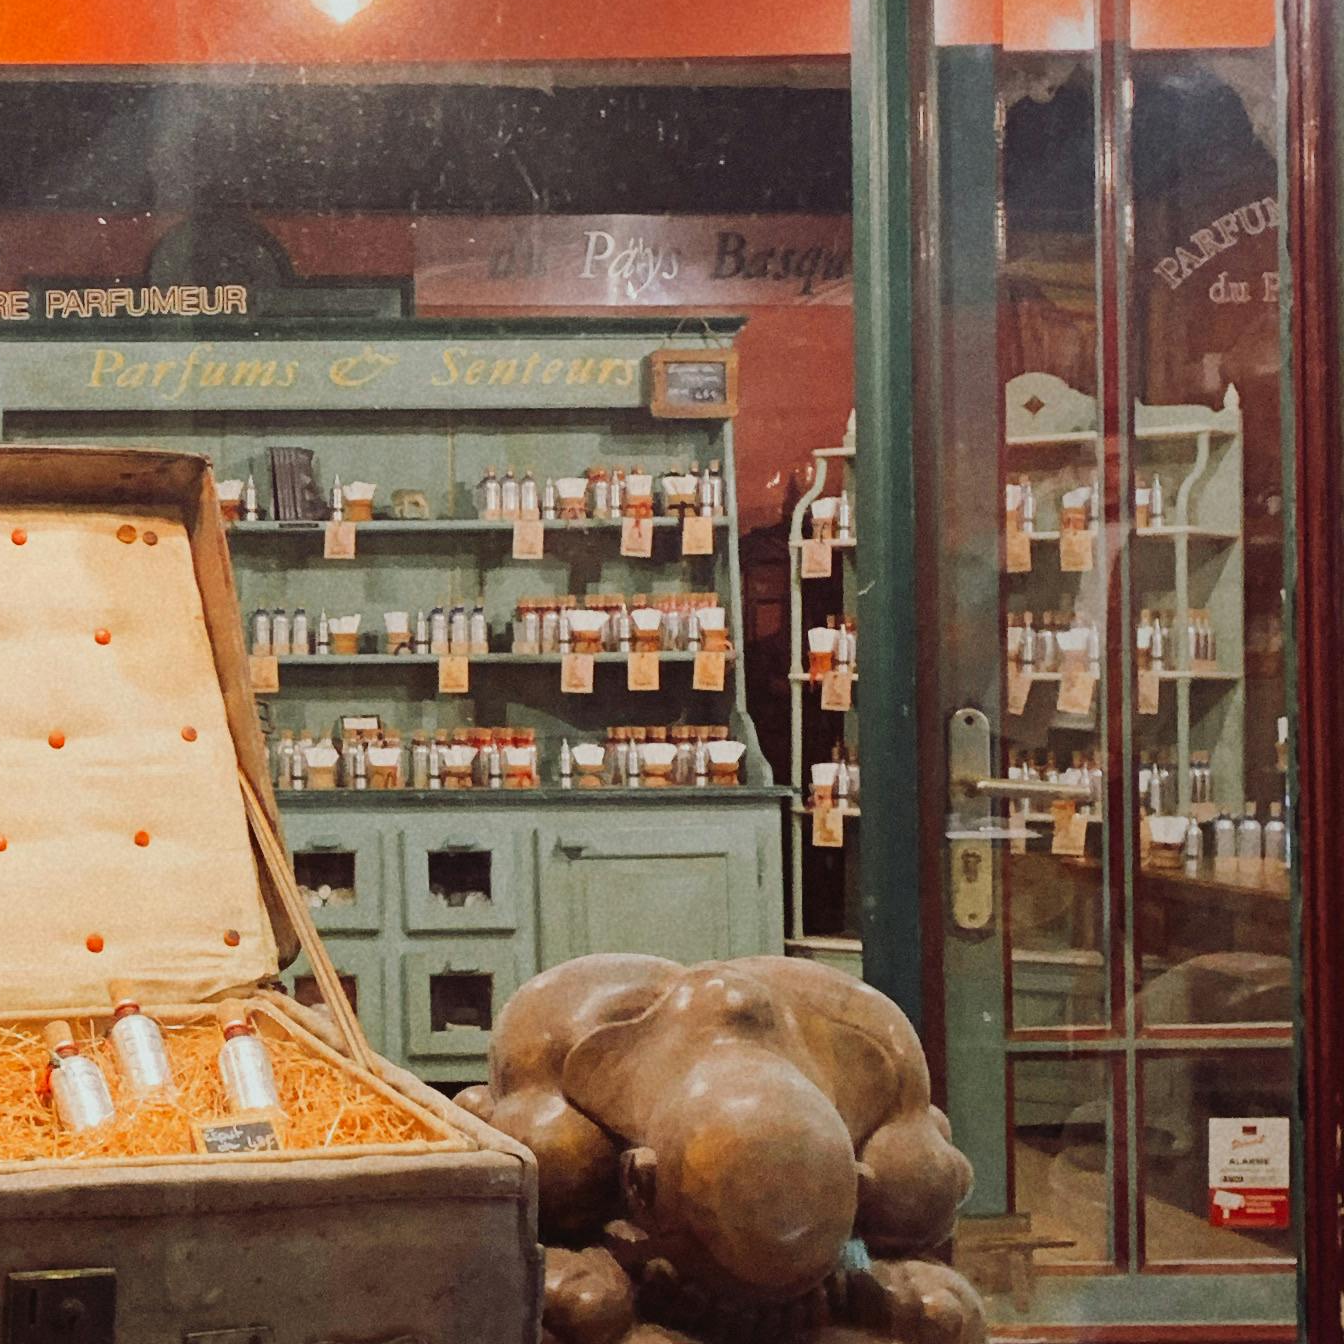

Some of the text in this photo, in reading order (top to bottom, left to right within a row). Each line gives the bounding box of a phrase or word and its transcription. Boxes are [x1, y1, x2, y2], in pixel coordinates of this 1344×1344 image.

[45, 285, 248, 319] PARFUMEUR
[1209, 271, 1253, 304] du
[86, 342, 300, 402] Parfums
[431, 345, 637, 388] Senteurs
